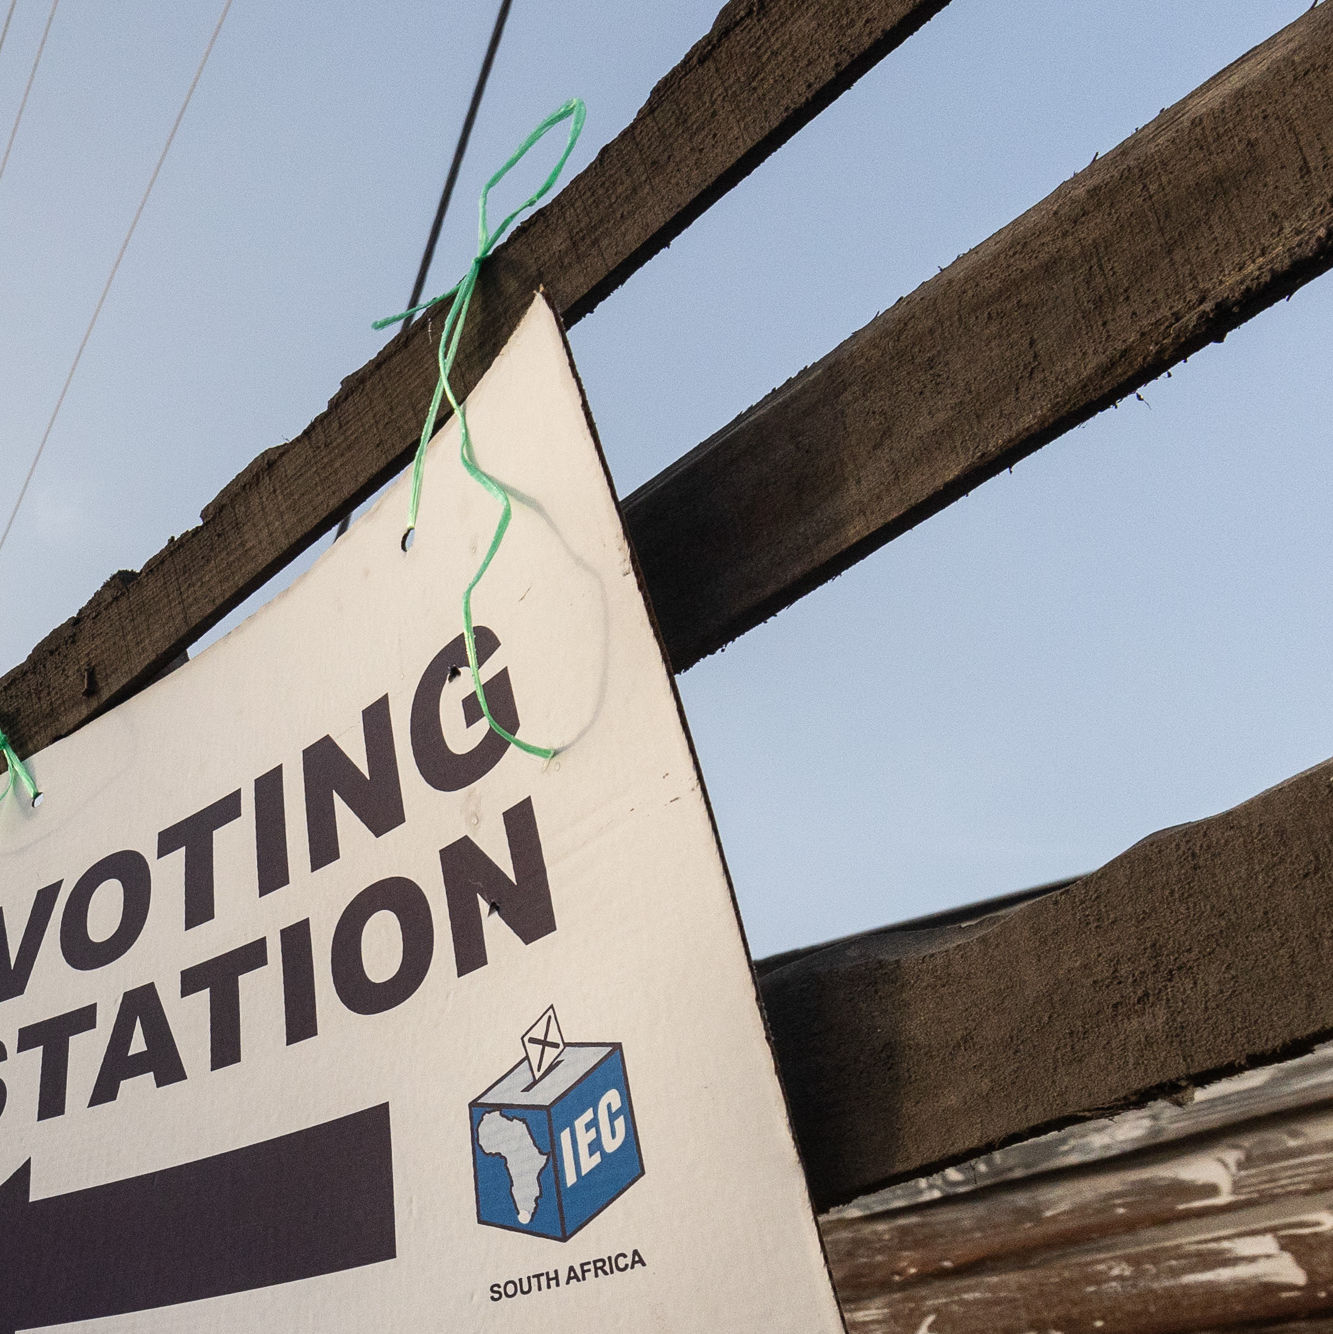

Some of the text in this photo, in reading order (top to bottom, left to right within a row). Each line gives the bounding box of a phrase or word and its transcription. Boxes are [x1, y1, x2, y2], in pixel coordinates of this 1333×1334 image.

[559, 1087, 626, 1189] IEC
[490, 1249, 646, 1302] SOUTH AFRICA
